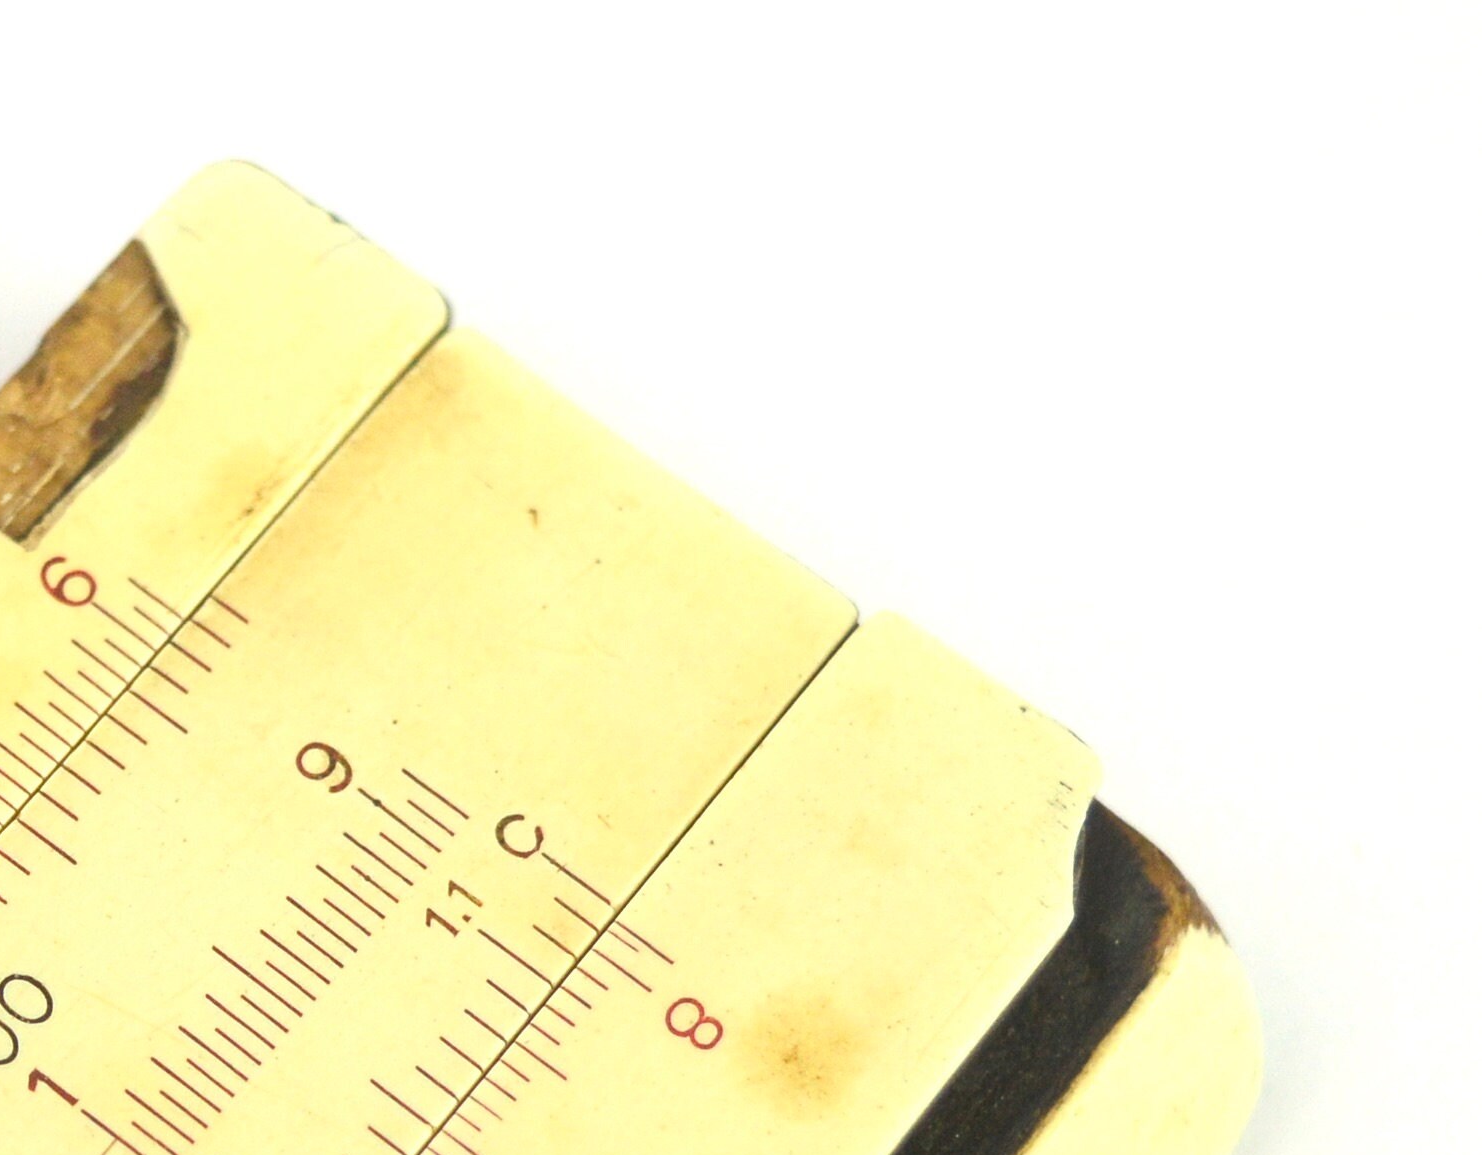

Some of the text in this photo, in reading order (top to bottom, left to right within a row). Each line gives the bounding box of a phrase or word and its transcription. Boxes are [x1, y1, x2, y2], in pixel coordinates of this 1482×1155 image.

[426, 880, 483, 936] 1.1
[665, 997, 724, 1050] 8
[28, 1068, 79, 1106] 1
